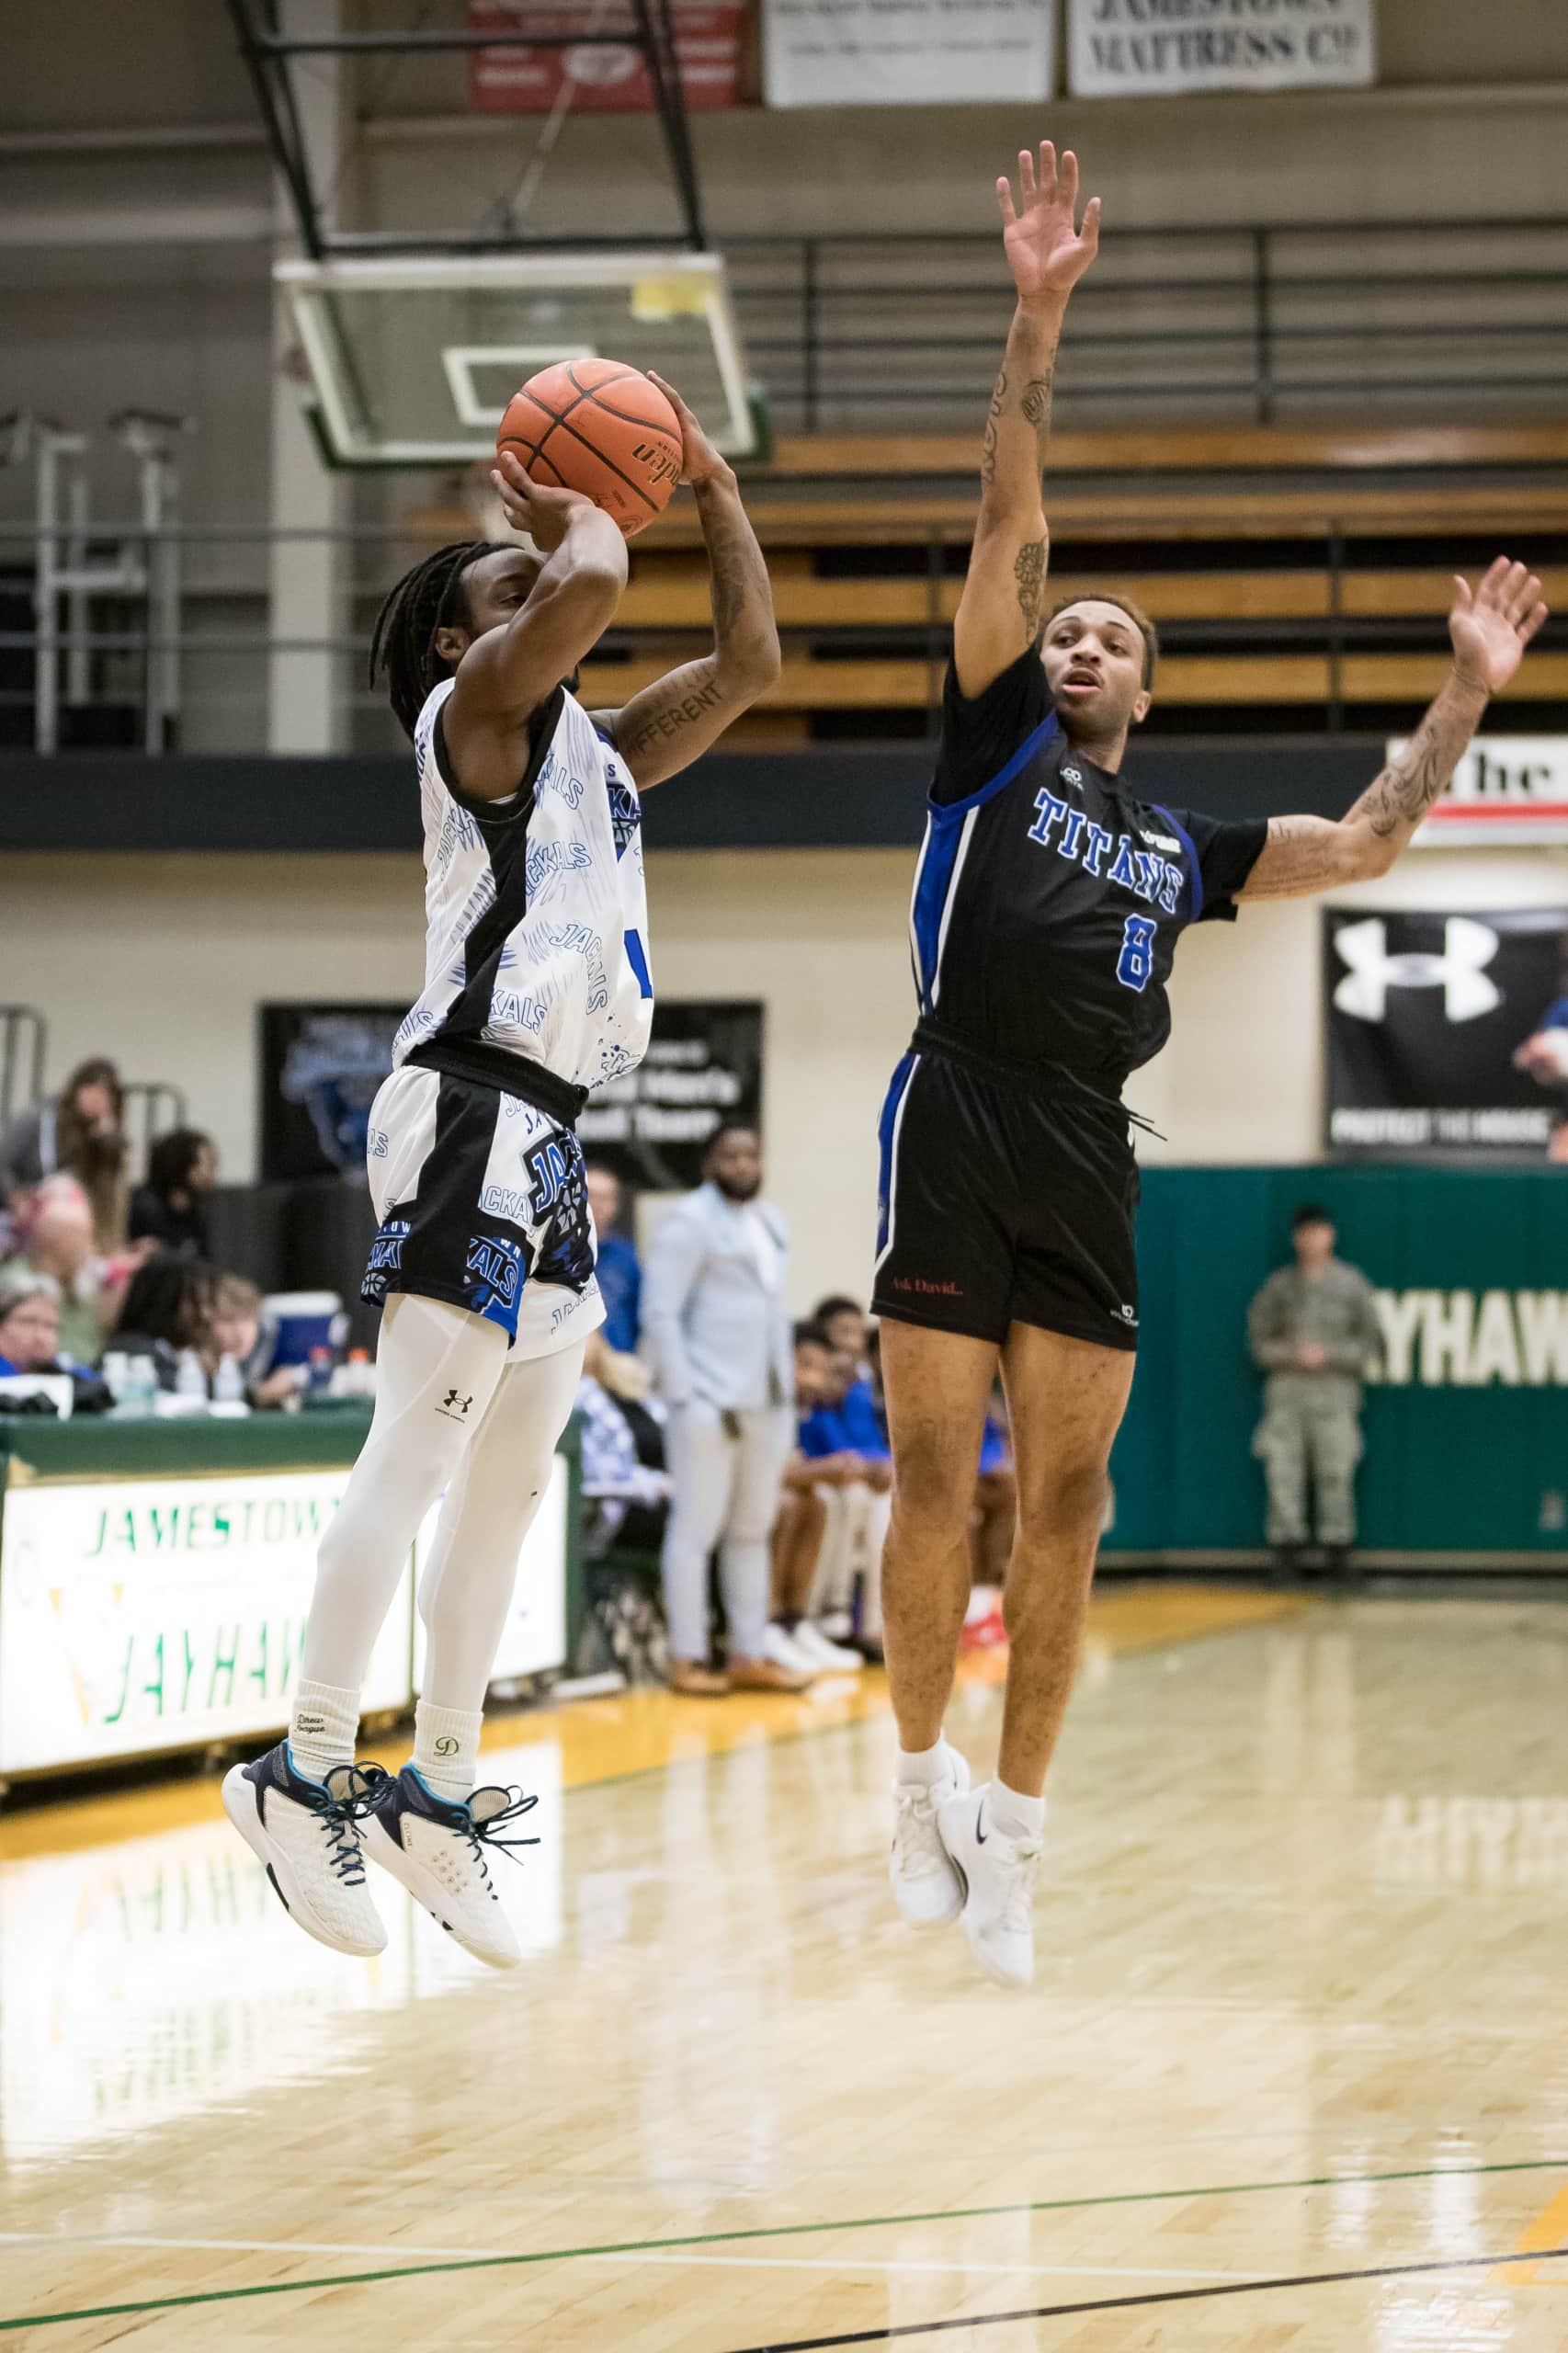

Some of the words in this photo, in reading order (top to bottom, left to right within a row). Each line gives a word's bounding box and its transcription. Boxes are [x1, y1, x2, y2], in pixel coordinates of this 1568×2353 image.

[1443, 749, 1551, 796] he
[1027, 787, 1184, 915] TITANS
[1116, 913, 1158, 994] 8
[83, 1495, 341, 1557] JAMESTOW
[434, 1735, 460, 1756] D
